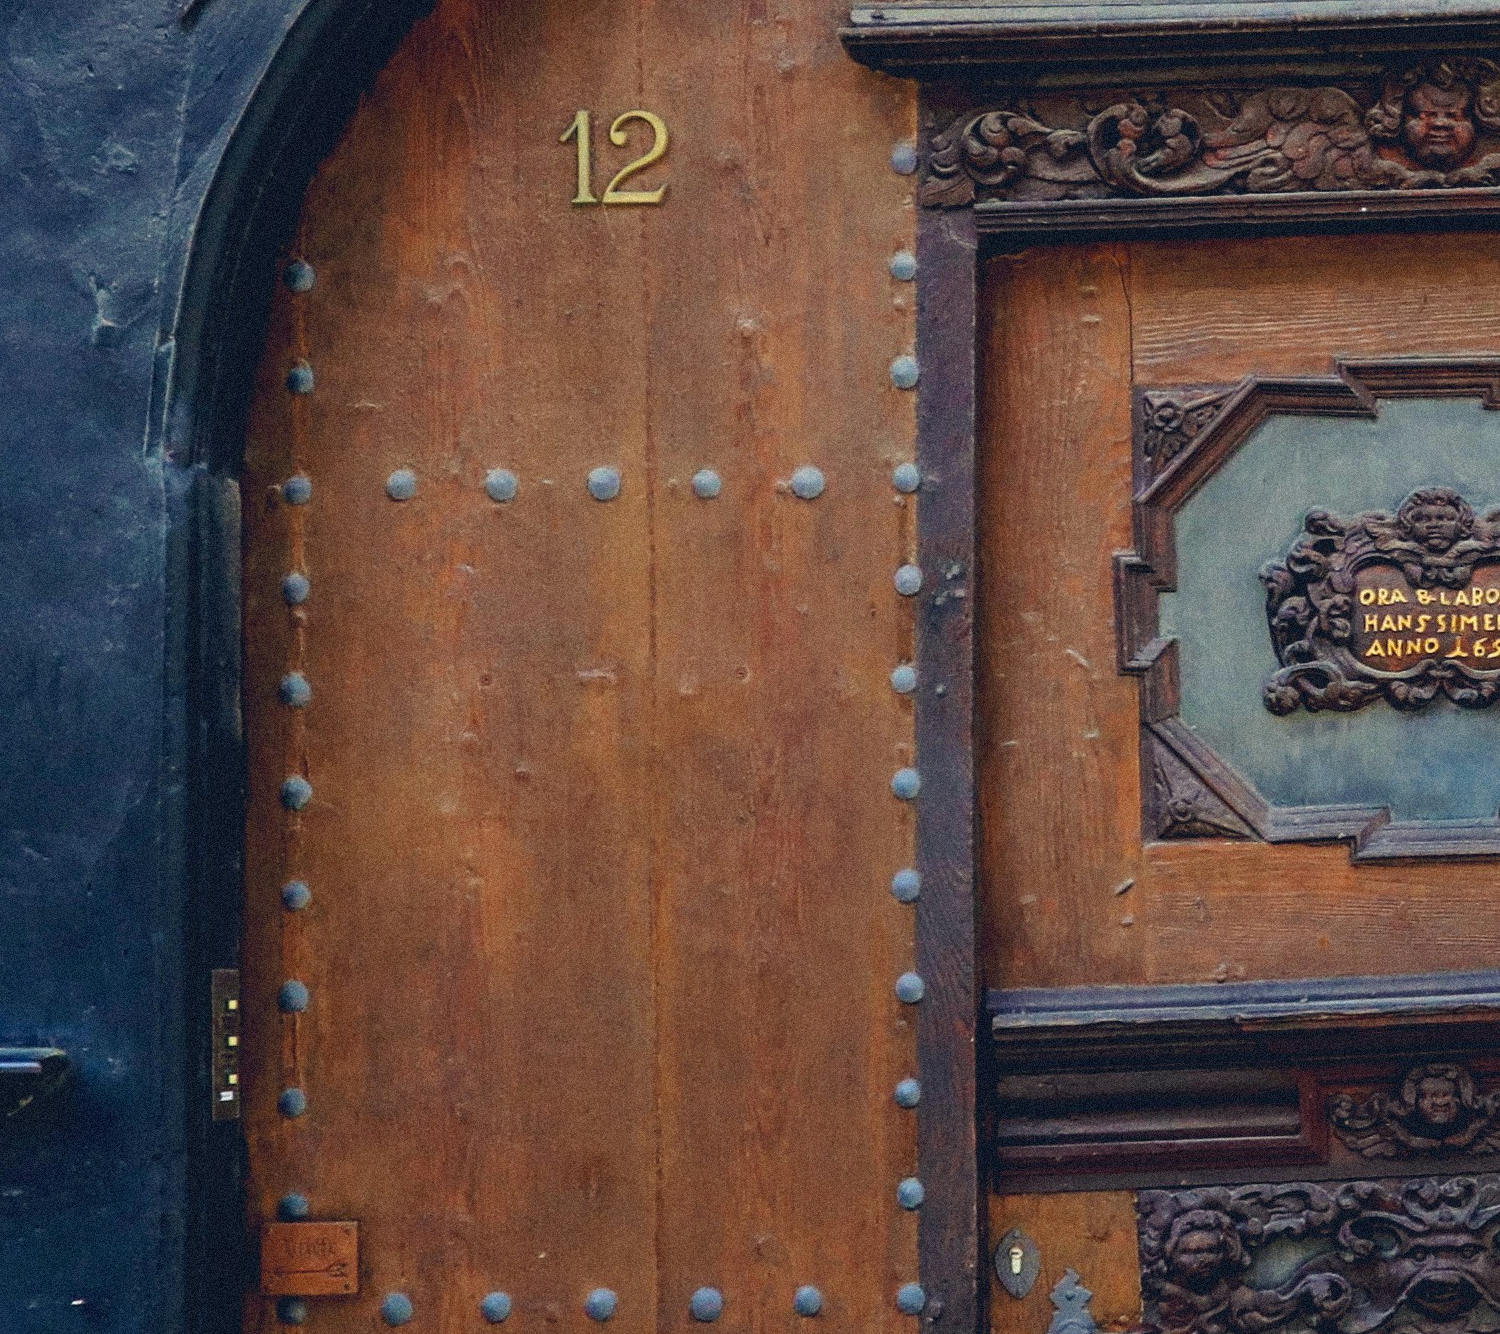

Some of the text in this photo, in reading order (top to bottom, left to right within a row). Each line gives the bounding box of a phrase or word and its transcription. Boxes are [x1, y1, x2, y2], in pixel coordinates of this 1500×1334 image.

[559, 109, 669, 203] 12
[1359, 587, 1408, 606] ORA
[1365, 637, 1440, 658] ANNO
